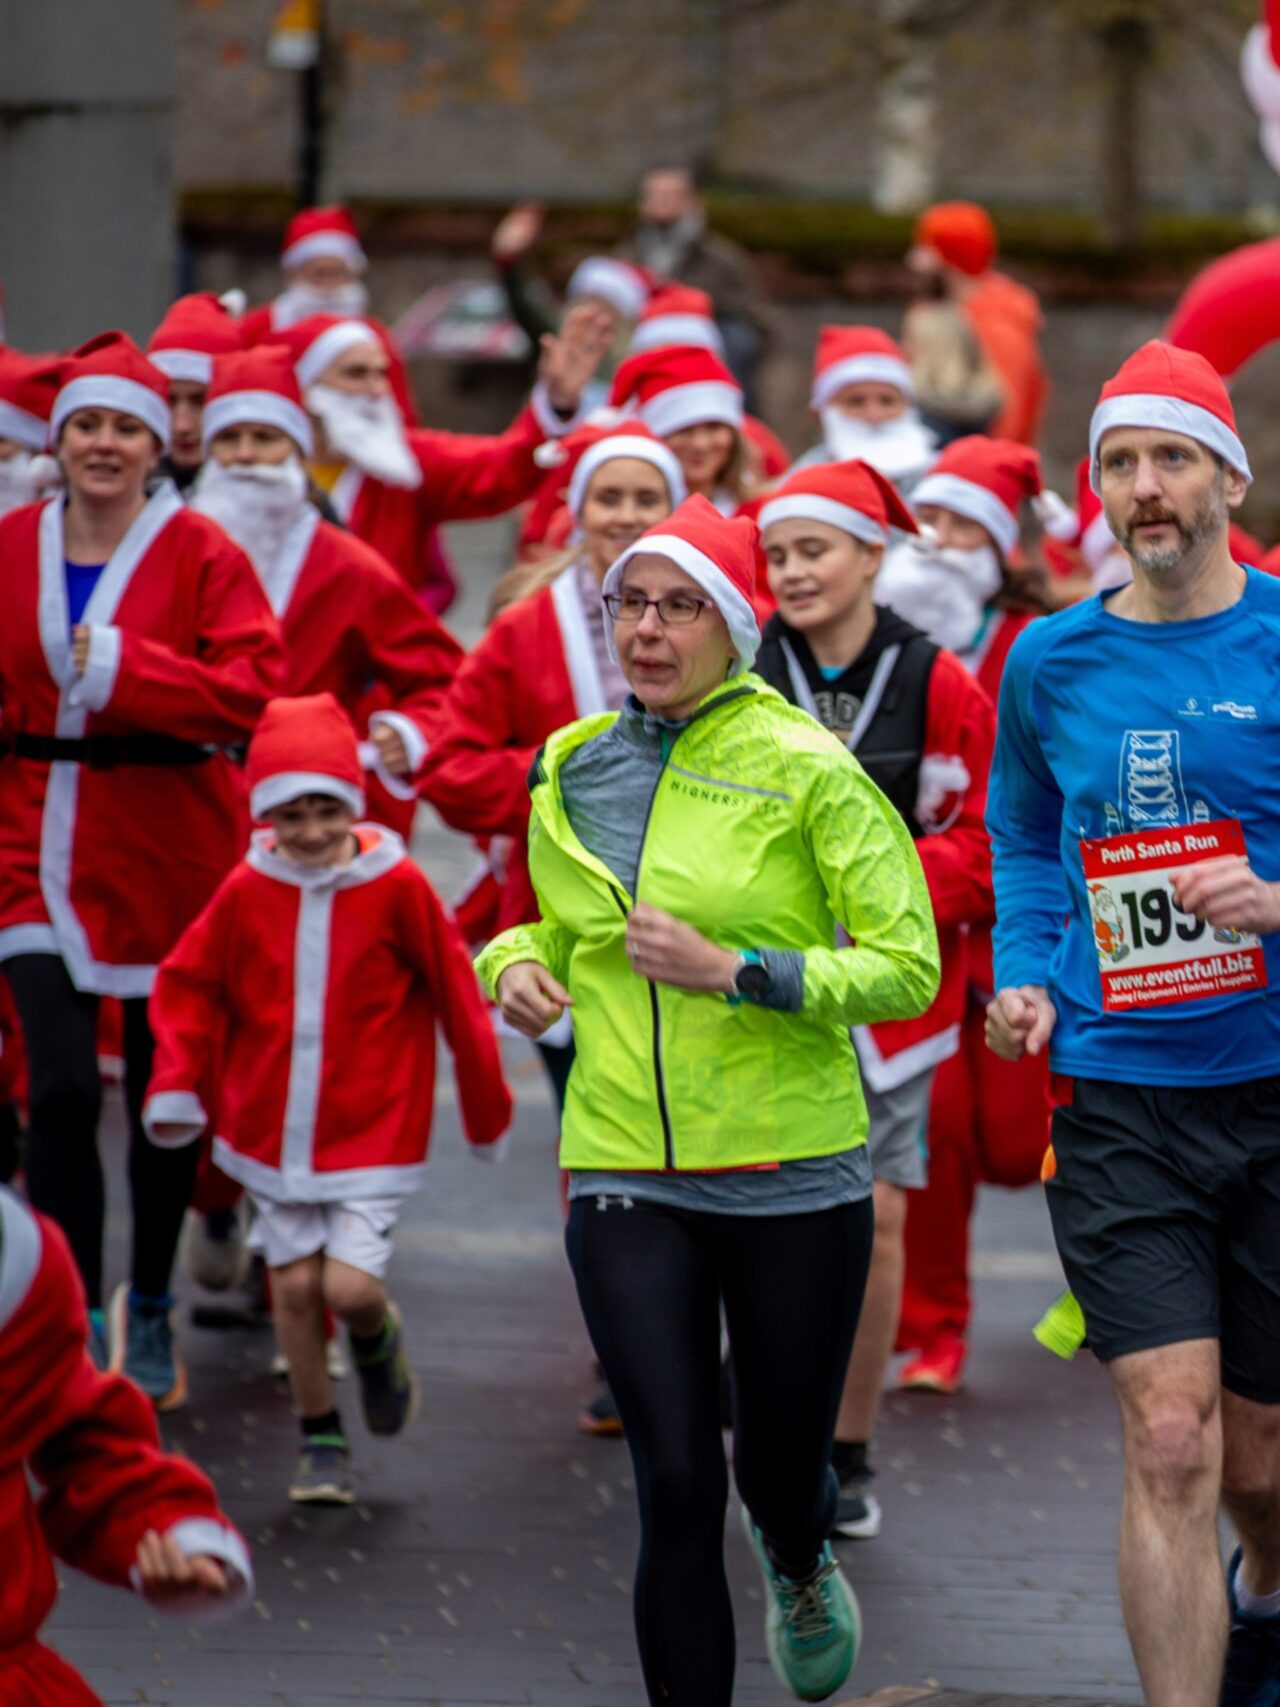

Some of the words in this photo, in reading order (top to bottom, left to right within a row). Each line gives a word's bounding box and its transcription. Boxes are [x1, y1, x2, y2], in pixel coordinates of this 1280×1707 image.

[1101, 844, 1135, 864] Perth
[1137, 840, 1181, 860] Santa
[1184, 834, 1219, 852] Run
[1108, 953, 1255, 992] www.eventfull.biz
